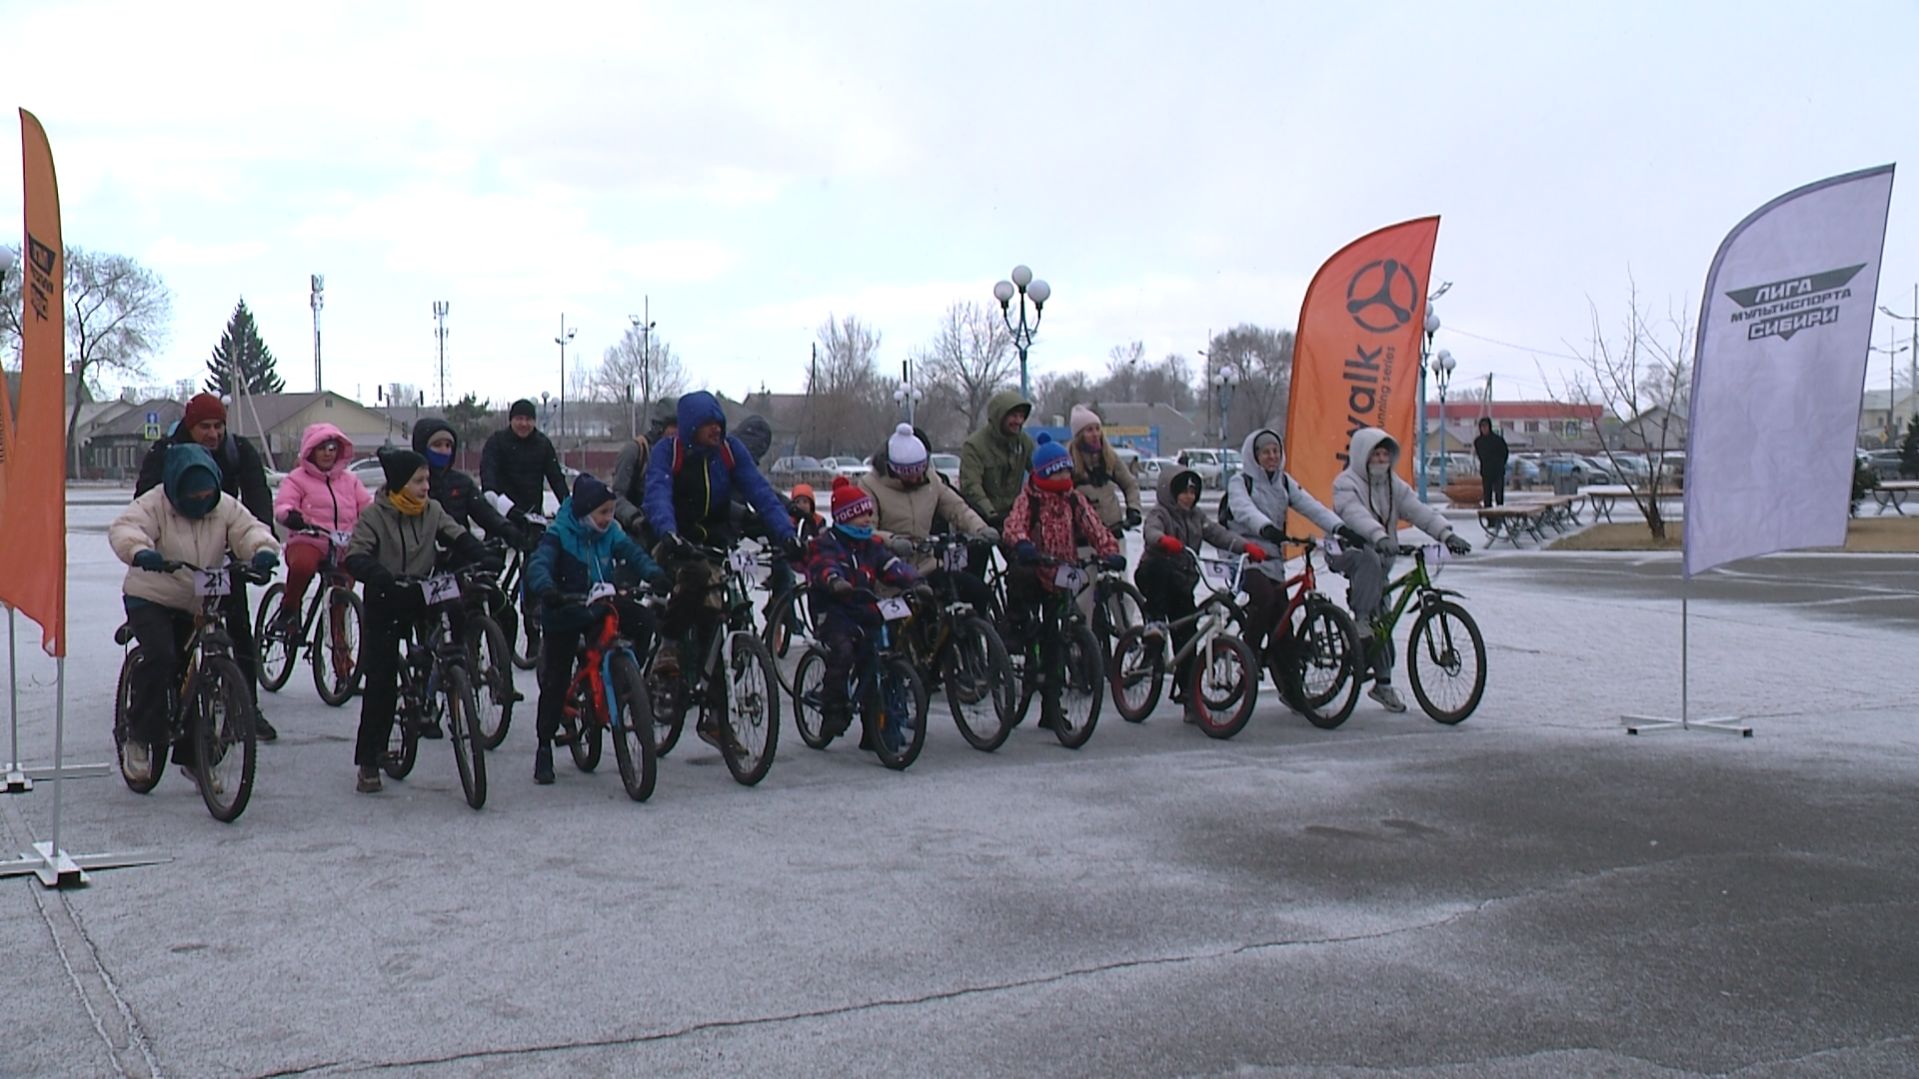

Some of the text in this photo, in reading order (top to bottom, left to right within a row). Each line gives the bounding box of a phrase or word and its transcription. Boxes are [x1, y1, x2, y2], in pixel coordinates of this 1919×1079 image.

[1731, 288, 1852, 323] МУЛЬТИСПОРТА
[1755, 278, 1813, 304] ЛИГА
[1749, 306, 1839, 340] СИБИРИ
[1376, 346, 1396, 429] unning series
